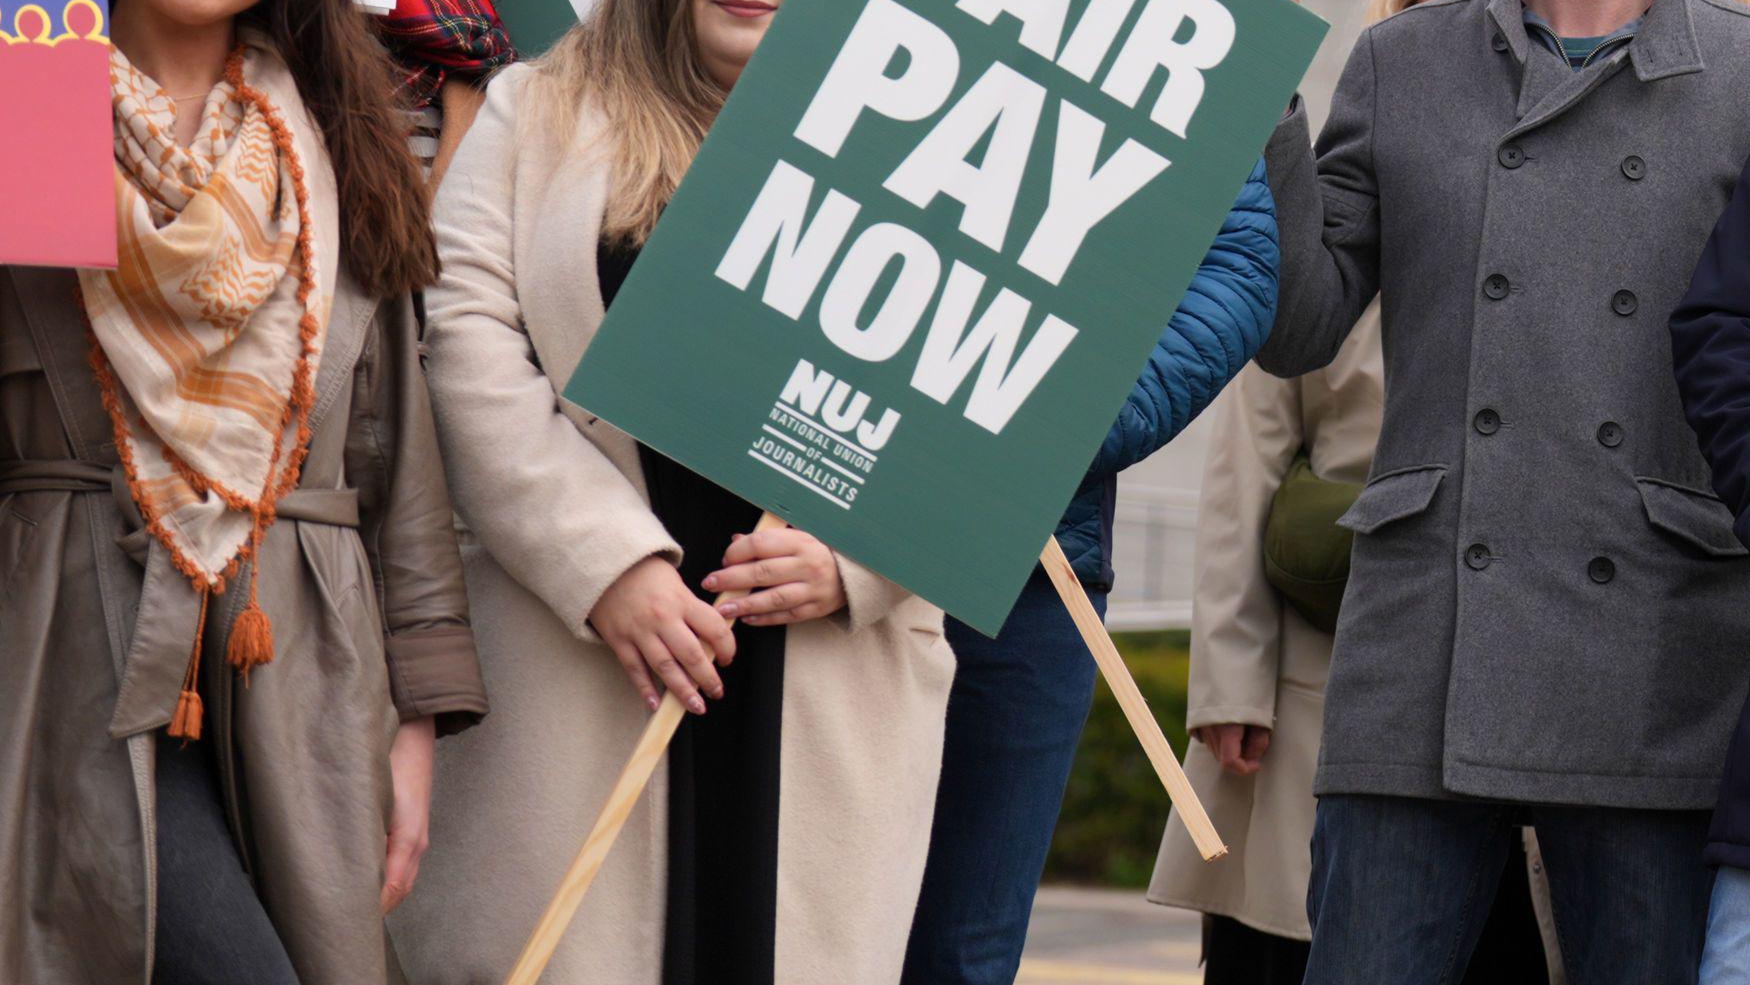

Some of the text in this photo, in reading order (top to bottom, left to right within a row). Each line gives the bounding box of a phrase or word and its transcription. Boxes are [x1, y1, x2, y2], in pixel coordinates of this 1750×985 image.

[714, 159, 1079, 435] NOW
[779, 358, 902, 451] NUJ
[753, 436, 859, 502] JOURNALISTS
[769, 408, 874, 473] NATIONAL UNION
[806, 447, 822, 461] OF
